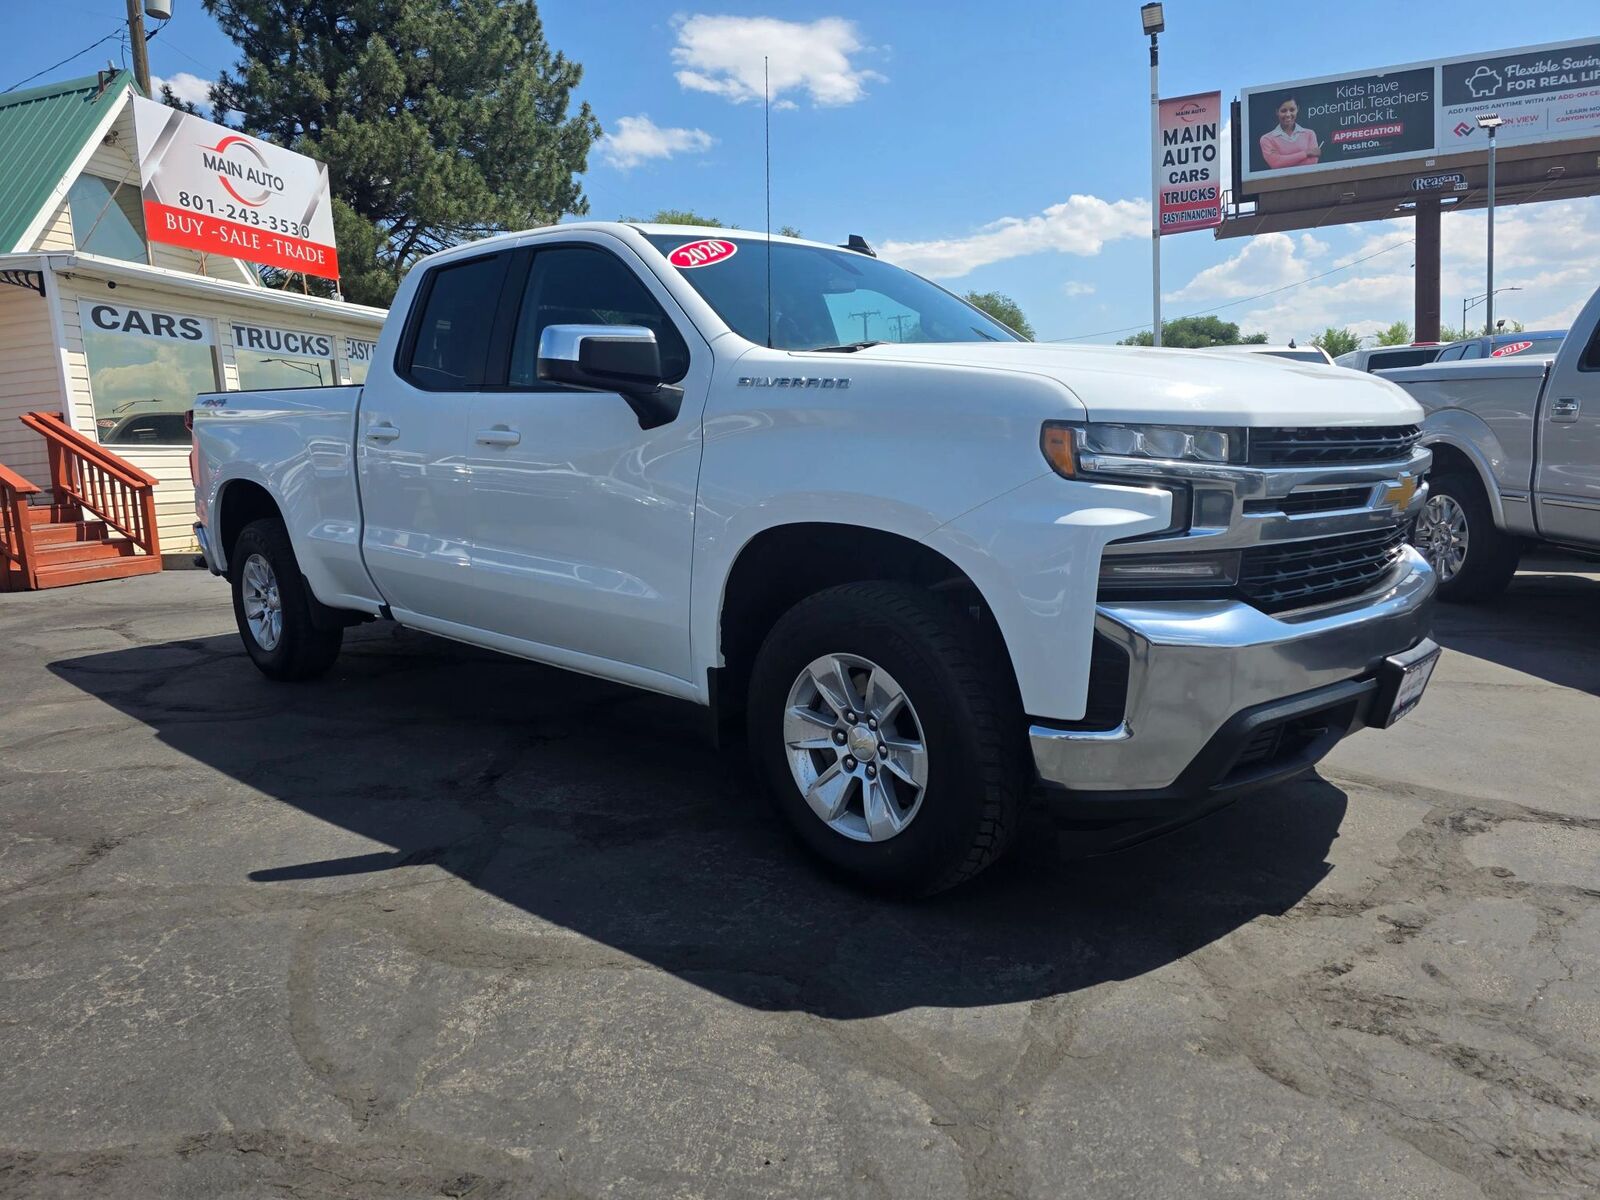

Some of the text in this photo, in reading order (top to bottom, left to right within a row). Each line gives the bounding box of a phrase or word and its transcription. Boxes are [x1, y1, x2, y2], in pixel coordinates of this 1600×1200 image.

[1504, 60, 1560, 78] Flexible
[1336, 80, 1399, 99] Kids have
[1507, 79, 1536, 92] FOR
[1540, 74, 1577, 87] REAL
[1191, 107, 1207, 116] AUTO
[1307, 90, 1429, 119] potential. Teachers
[1448, 107, 1463, 116] ADD
[1465, 105, 1489, 113] FUNDS
[1491, 100, 1523, 109] ANYTIME
[1525, 97, 1544, 105] WITH
[1558, 91, 1588, 100] ADD-ON
[1340, 108, 1398, 126] unlock it.
[1516, 115, 1540, 124] VIEW
[1163, 123, 1217, 146] MAIN
[1333, 126, 1401, 141] APPRECIATION
[1162, 144, 1217, 167] AUTO
[203, 152, 285, 192] MAIN AUTO
[1168, 168, 1210, 184] CARS
[1163, 187, 1217, 205] TRUCKS
[165, 212, 204, 237] BUY
[178, 191, 311, 239] 801-243-3530
[1163, 207, 1217, 224] EASY FINANCING
[679, 240, 726, 266] 2020
[91, 305, 204, 341] CARS
[231, 325, 331, 357] TRUCKS
[737, 376, 852, 390] SILVERADO
